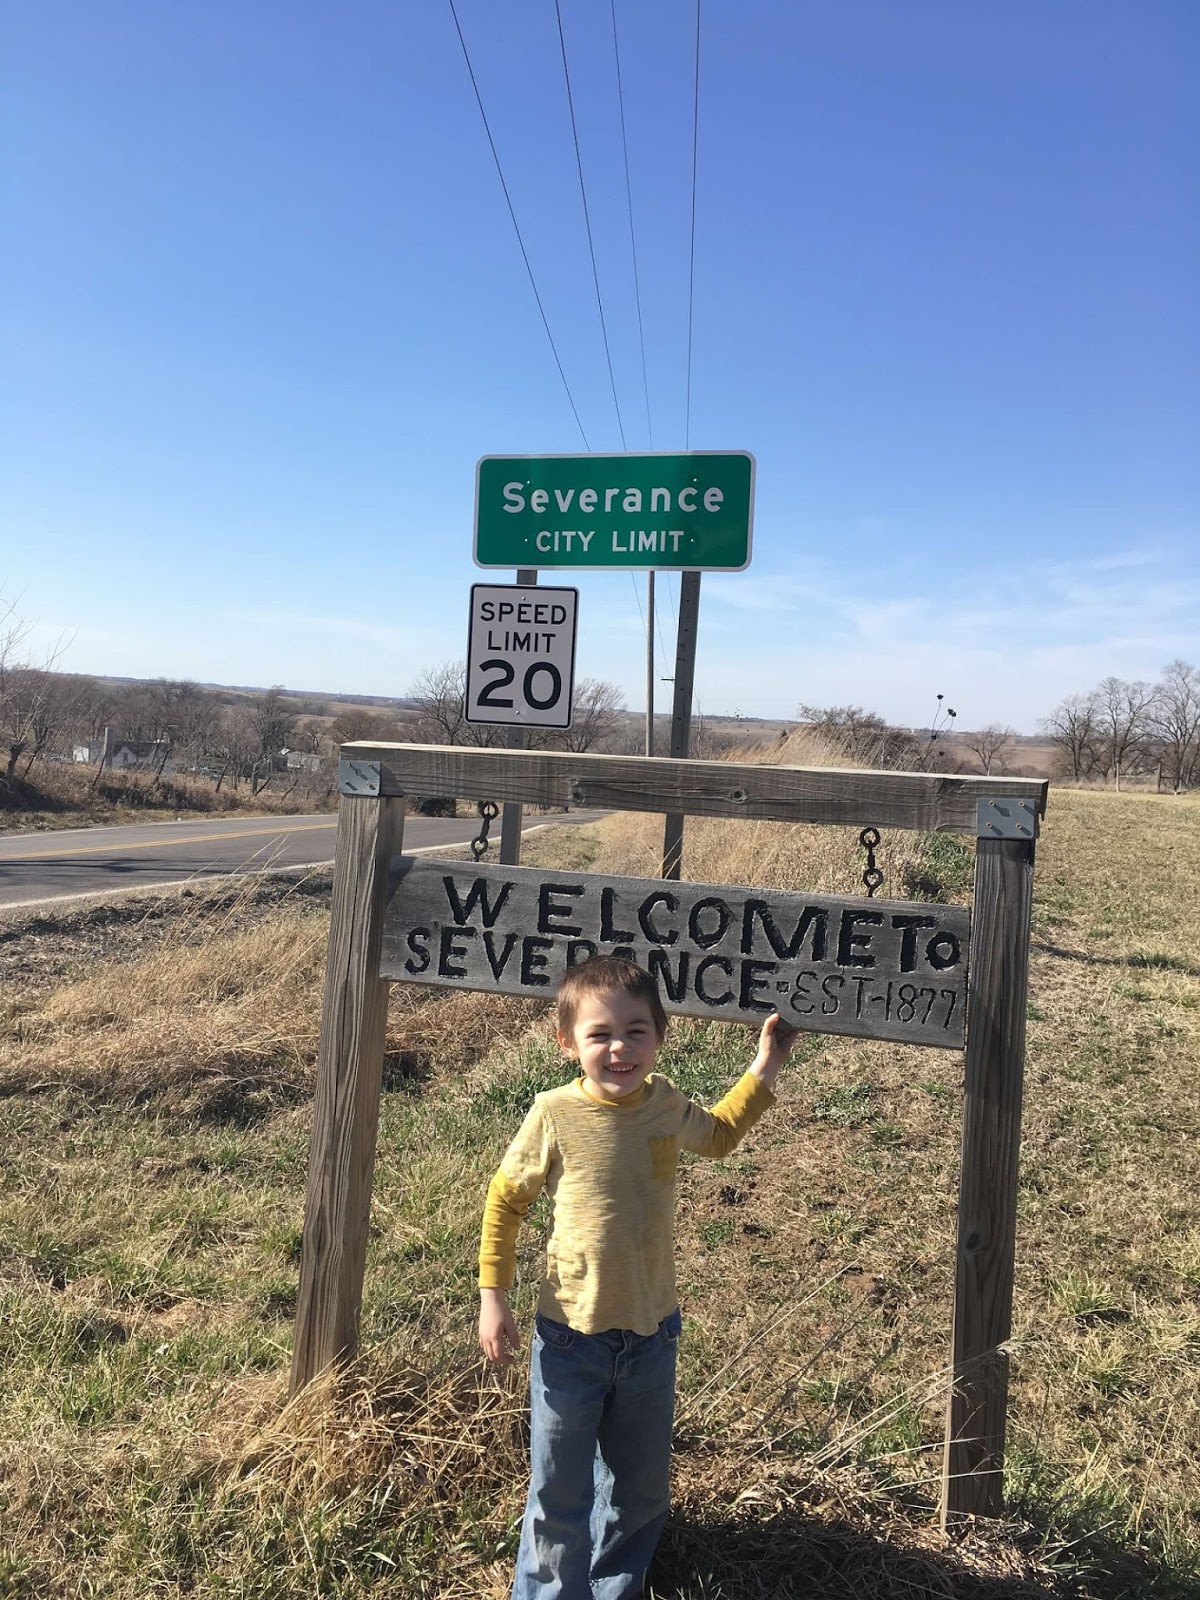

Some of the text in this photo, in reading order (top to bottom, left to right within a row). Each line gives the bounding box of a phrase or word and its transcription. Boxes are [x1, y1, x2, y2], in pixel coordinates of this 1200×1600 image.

[502, 481, 724, 514] Severance
[535, 530, 685, 553] CITY LIMIT
[480, 601, 567, 625] SPEED
[487, 630, 556, 654] LIMIT
[476, 659, 562, 711] 20
[442, 875, 886, 969] WELCOME
